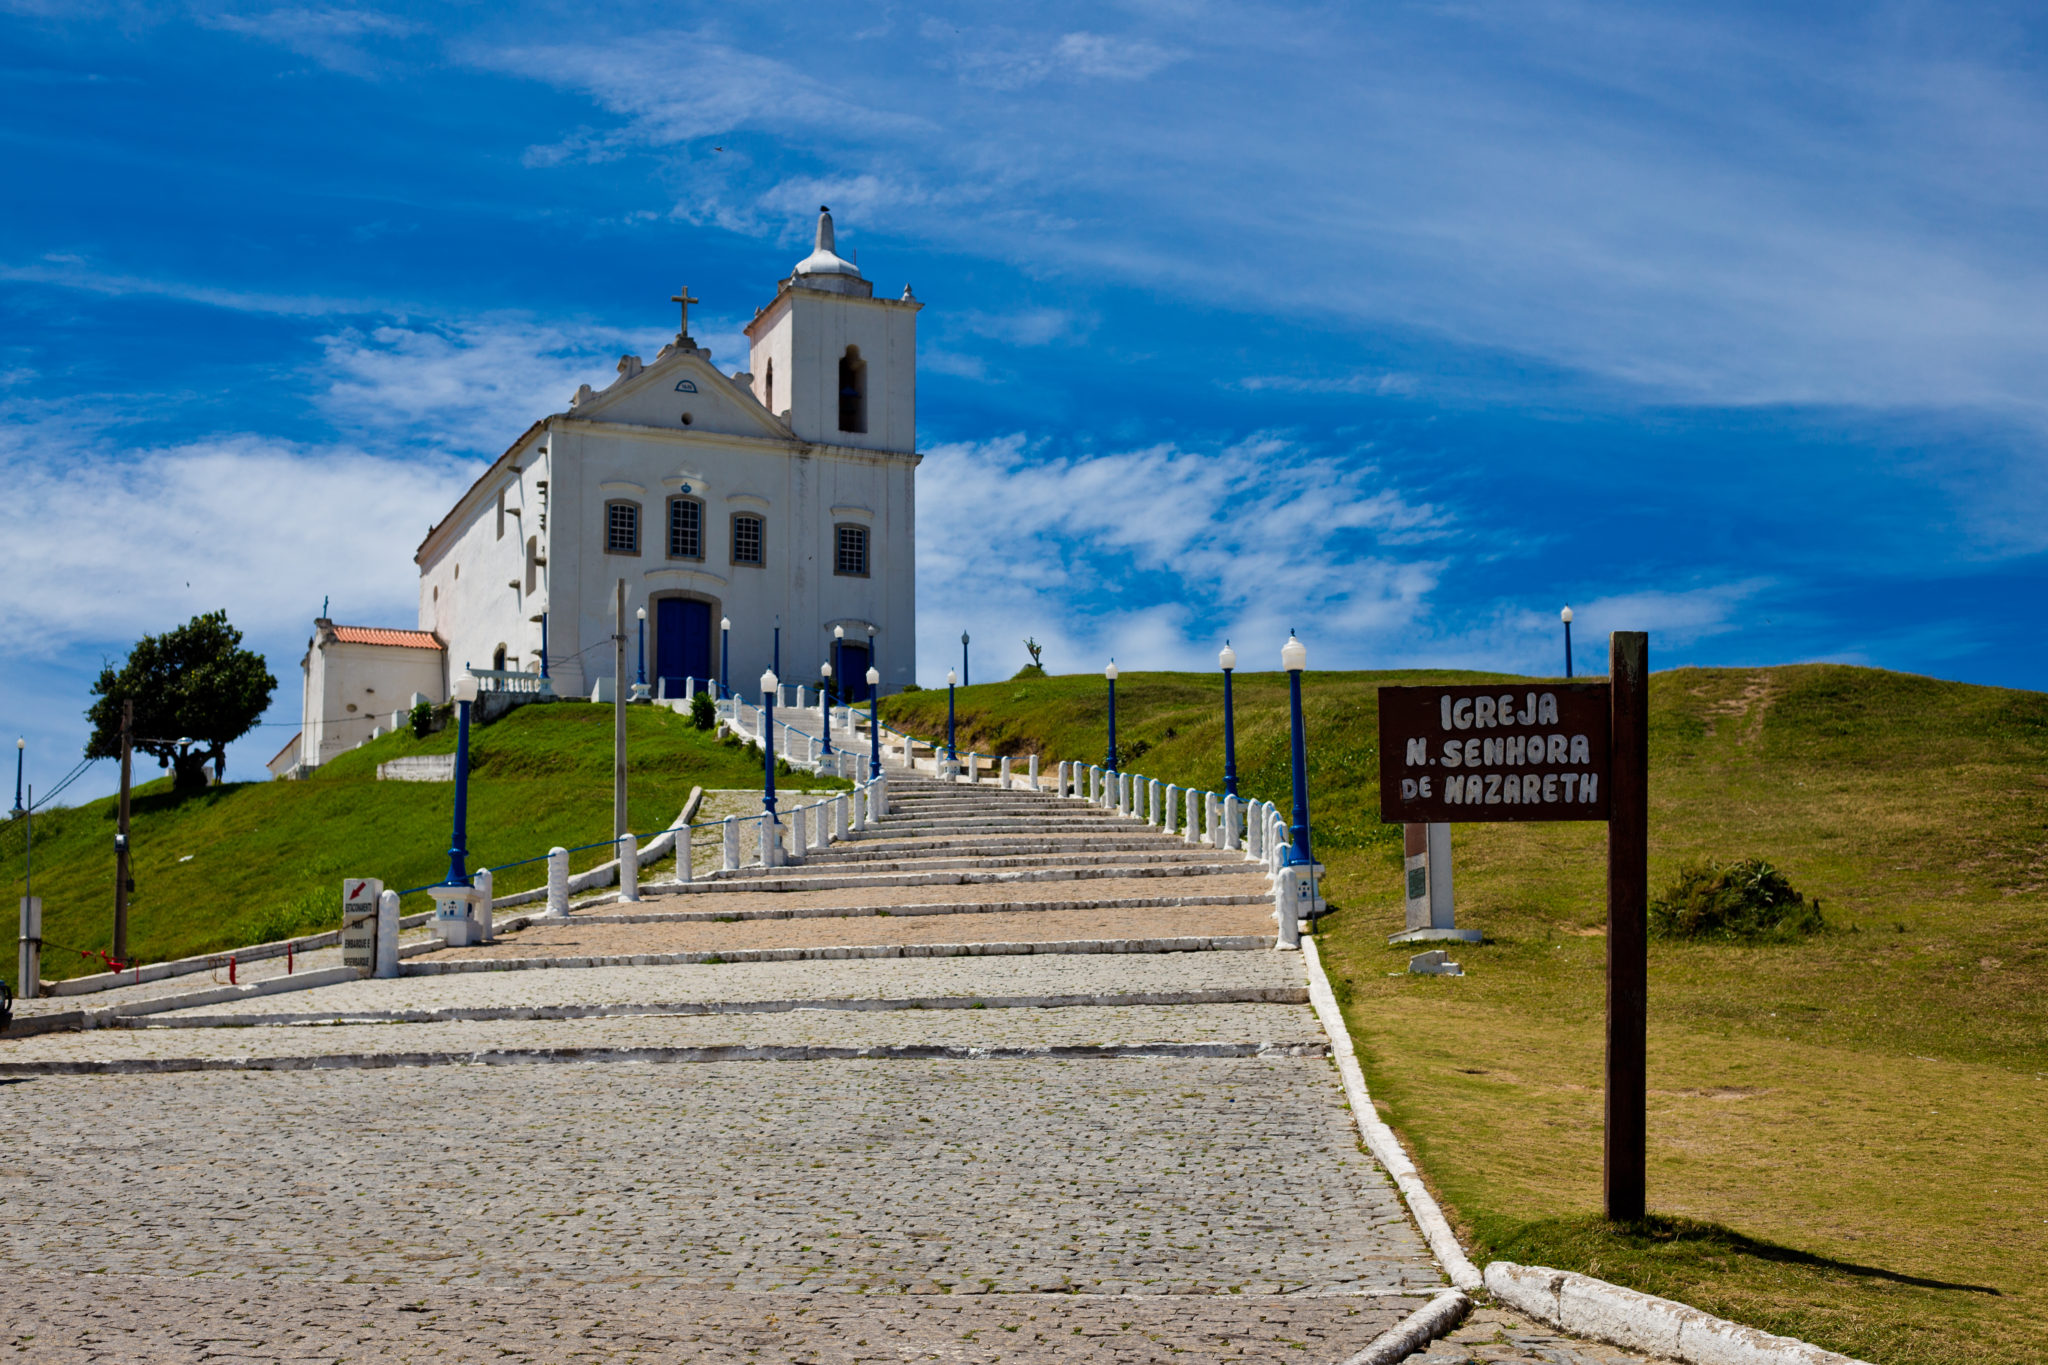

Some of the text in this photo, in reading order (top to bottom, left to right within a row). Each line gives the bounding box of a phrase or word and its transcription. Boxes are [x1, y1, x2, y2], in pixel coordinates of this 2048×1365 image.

[1441, 692, 1558, 730] IGREJA
[1440, 734, 1590, 768] SENHORA
[1401, 773, 1599, 805] DE NAZARETH
[345, 938, 366, 949] EMBARQUE
